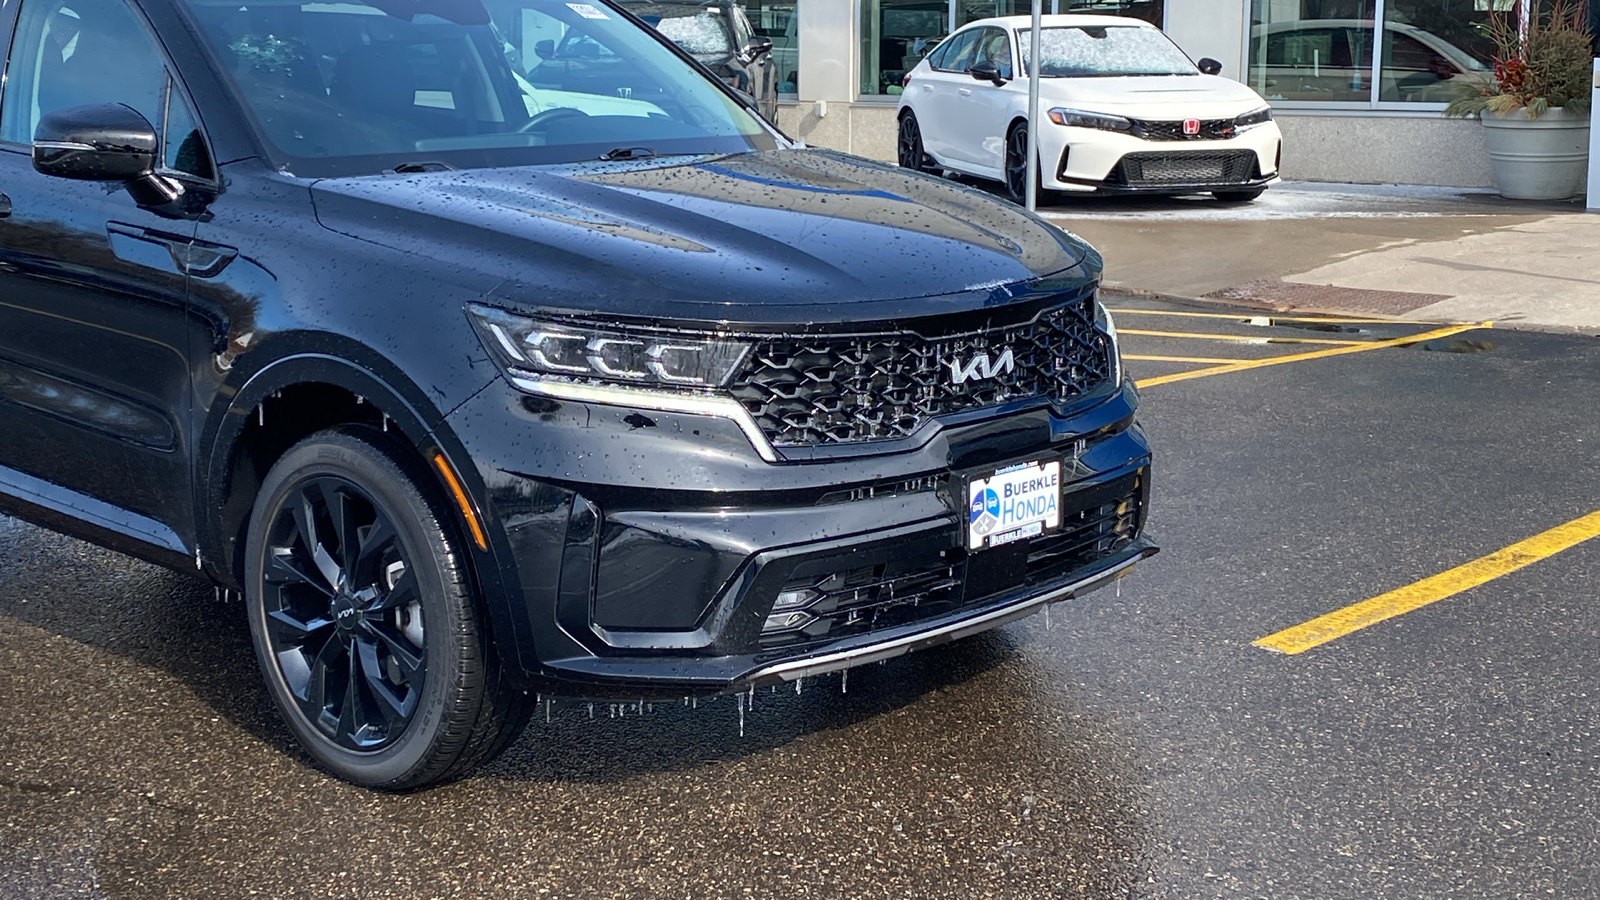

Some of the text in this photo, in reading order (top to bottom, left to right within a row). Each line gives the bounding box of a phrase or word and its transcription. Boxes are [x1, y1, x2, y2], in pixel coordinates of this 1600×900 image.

[1004, 474, 1057, 498] BUERKLE
[1002, 493, 1056, 525] HONDA
[991, 530, 1022, 545] BUERKLE
